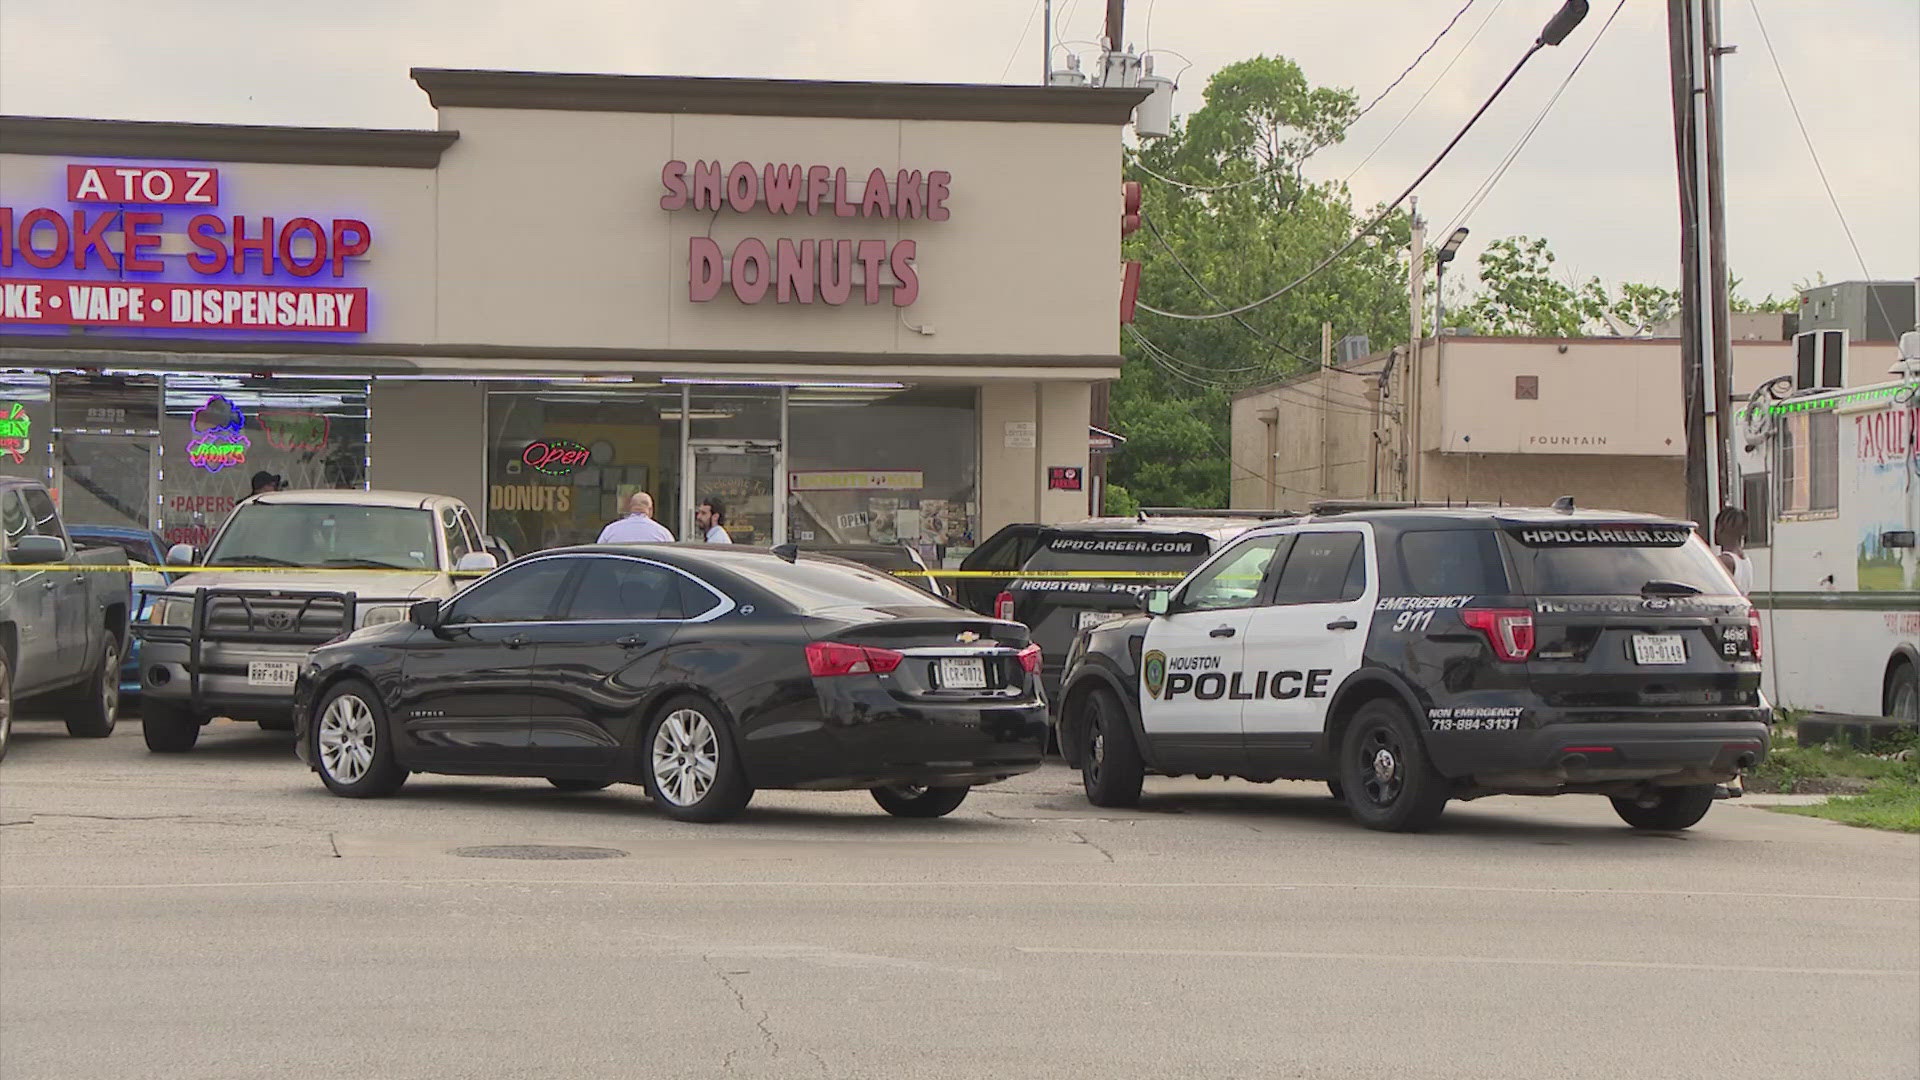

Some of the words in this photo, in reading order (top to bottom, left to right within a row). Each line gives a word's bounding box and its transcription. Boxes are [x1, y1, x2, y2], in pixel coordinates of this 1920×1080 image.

[76, 169, 108, 201] A
[116, 169, 174, 201] TO
[185, 171, 212, 203] Z
[660, 159, 951, 222] SNOWFLAKE
[186, 213, 371, 278] SHOP
[689, 237, 919, 307] DONUTS
[0, 284, 43, 318] KE
[68, 286, 145, 321] VAPE
[171, 288, 355, 327] DISPENSARY
[1530, 436, 1607, 445] FOUNTAIN
[522, 442, 591, 468] Open
[176, 496, 236, 513] PAPERS
[489, 484, 571, 513] DONUTS
[839, 513, 867, 528] OPEN
[1523, 529, 1690, 544] HPDCAREER.COM
[1051, 539, 1193, 553] HPDCAREER.COM
[1021, 581, 1092, 592] HOUSTON
[1376, 595, 1475, 610] EMERGENCY
[1393, 609, 1436, 632] 911
[1169, 656, 1221, 671] HOUSTON
[1164, 669, 1332, 701] POLICE
[1429, 708, 1451, 718] NON
[1453, 707, 1524, 717] EMERGENCY
[1431, 718, 1519, 731] 713-884-3131
